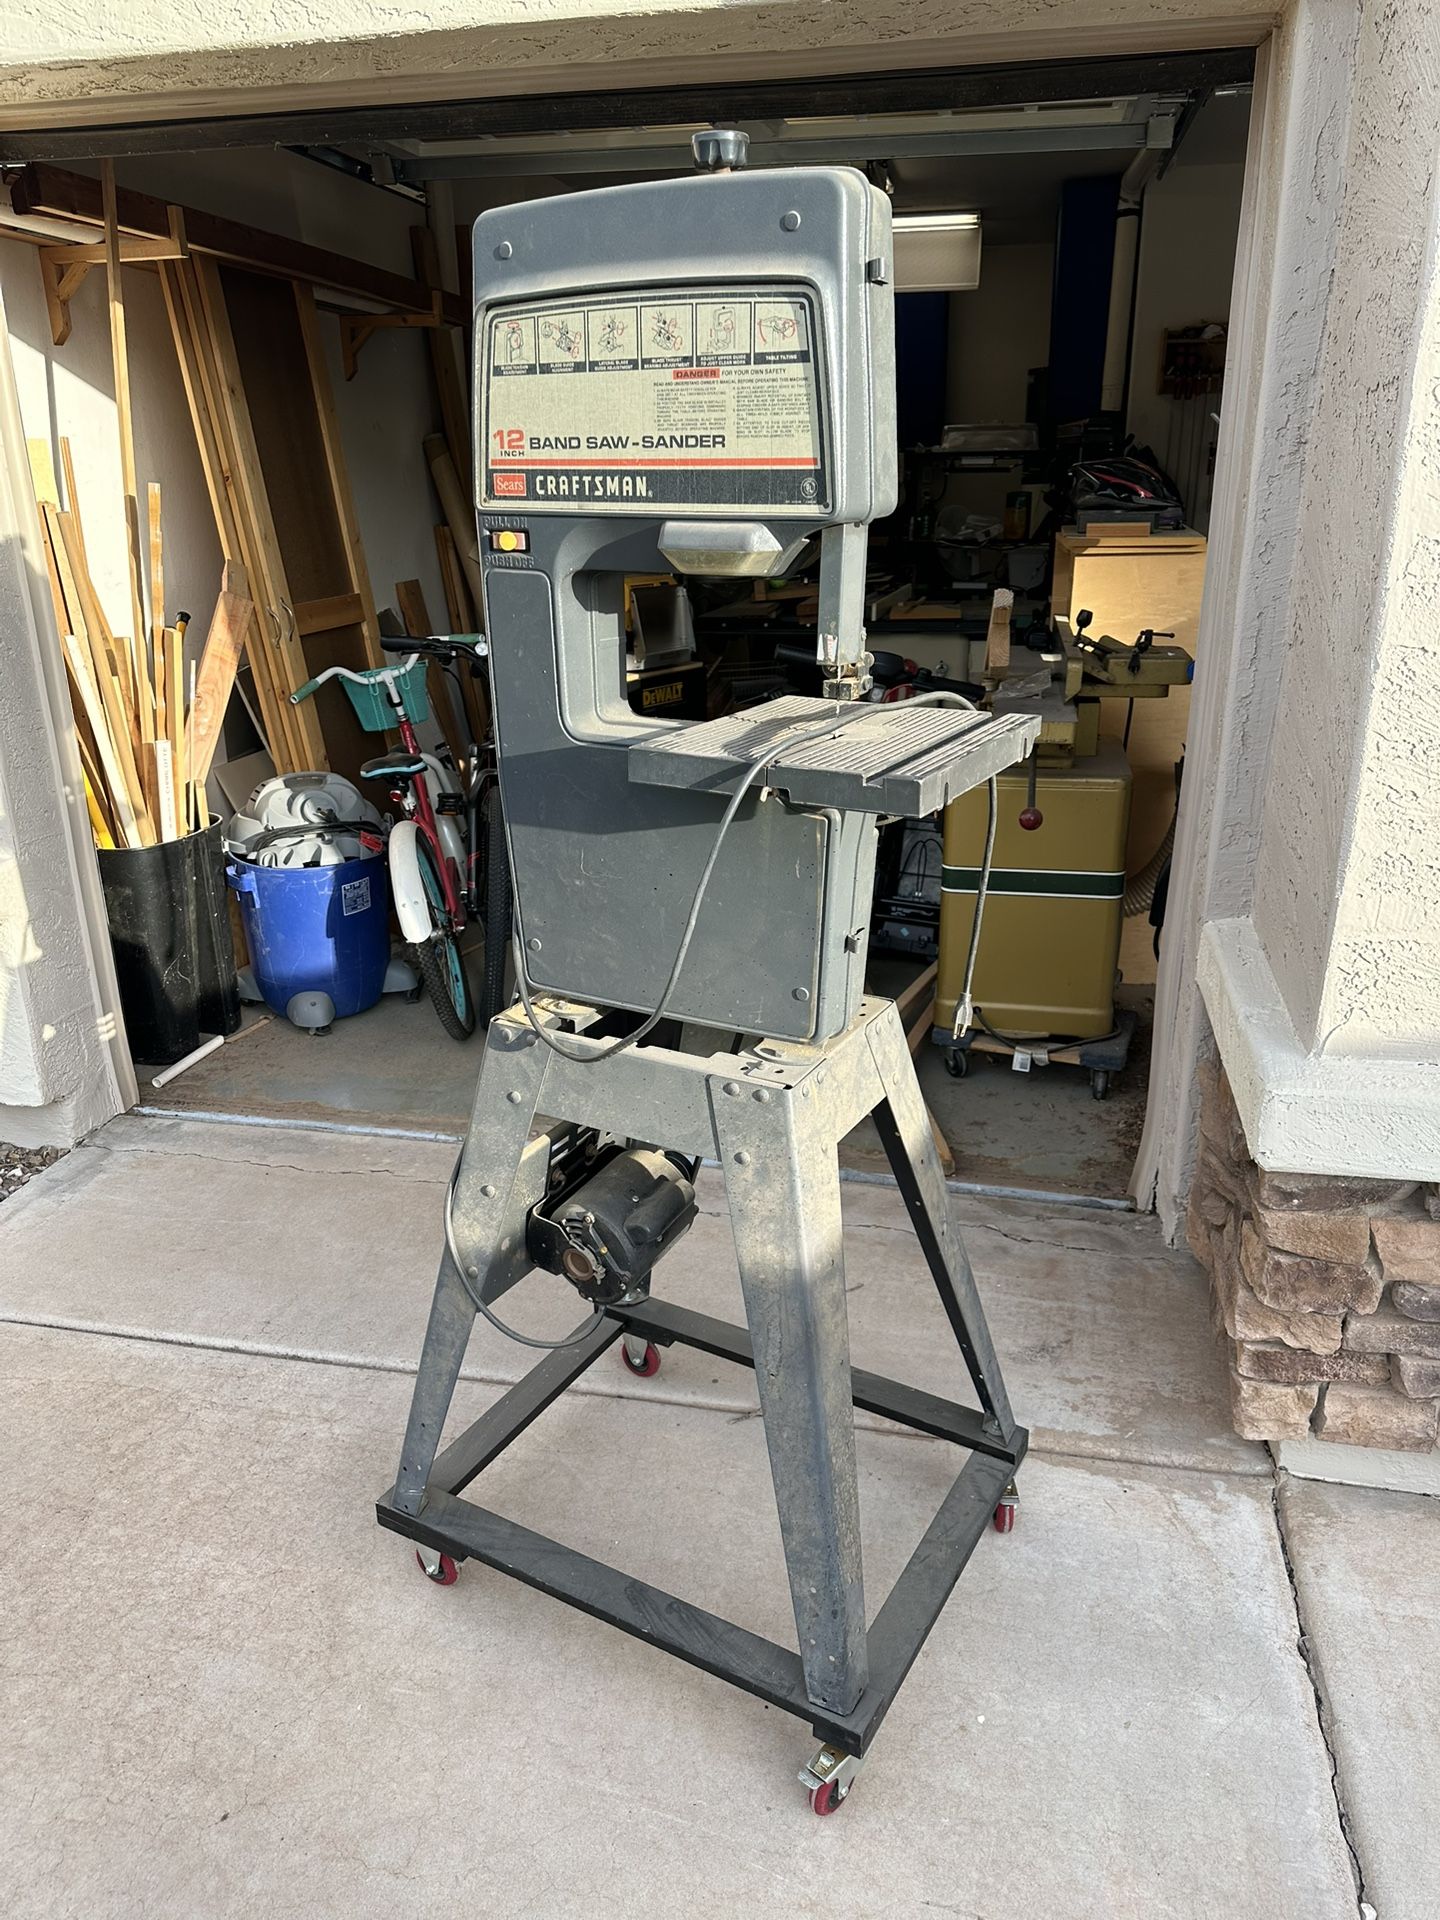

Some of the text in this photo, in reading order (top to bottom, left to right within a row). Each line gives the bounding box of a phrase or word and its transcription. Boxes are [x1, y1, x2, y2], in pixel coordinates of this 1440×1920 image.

[676, 370, 716, 379] DANGER
[493, 429, 525, 449] 12
[530, 436, 581, 449] BAND
[496, 477, 524, 491] Sears
[483, 516, 529, 528] PULL ON
[484, 554, 535, 568] PUSH OFF
